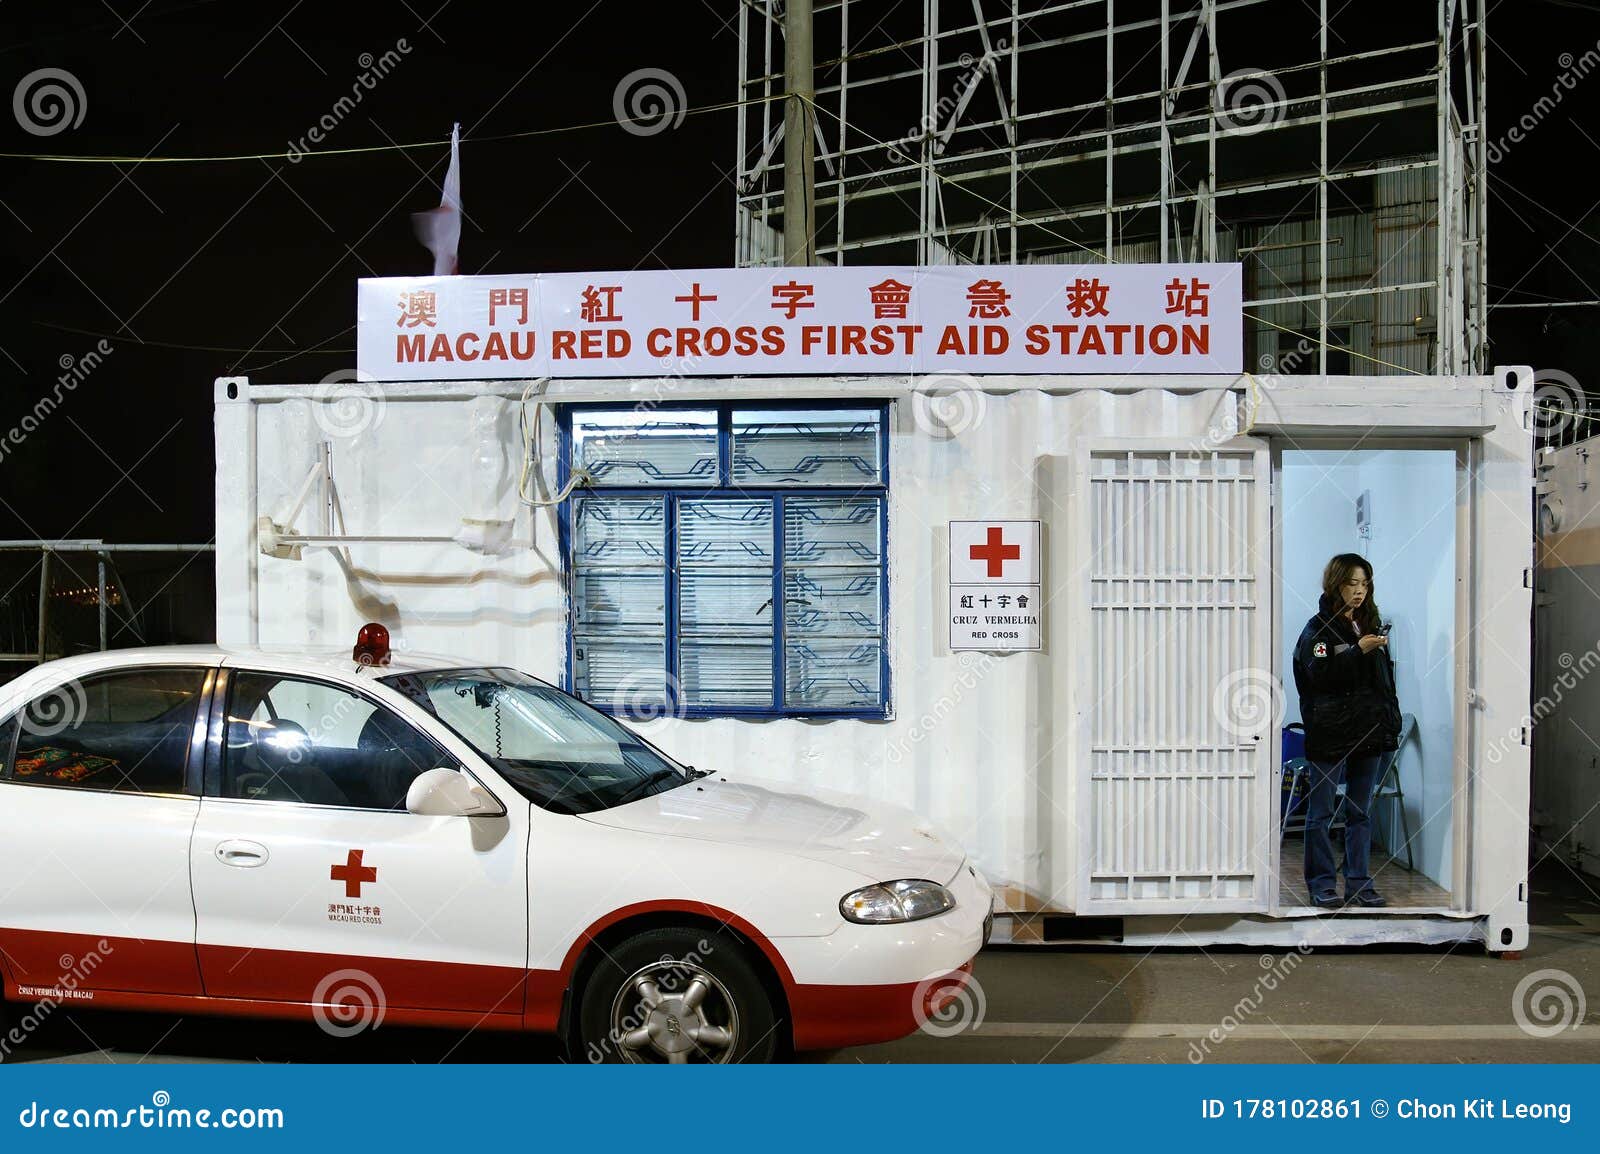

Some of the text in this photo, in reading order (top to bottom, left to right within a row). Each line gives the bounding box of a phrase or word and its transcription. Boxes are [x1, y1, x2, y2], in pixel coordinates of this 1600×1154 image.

[397, 277, 1210, 328] 澳門紅十字會急救站
[397, 324, 1209, 362] MACAU RED CROSS FIRST AID STATION
[960, 594, 1029, 609] 紅十字會
[952, 615, 1037, 625] CRUZ VERMELHA
[971, 631, 1019, 639] RED CROSS
[328, 904, 381, 916] 澳門紅十字會
[328, 914, 382, 925] MACAU RED CROSS
[18, 985, 94, 1000] CRUZ VERMELHA DE MACAU
